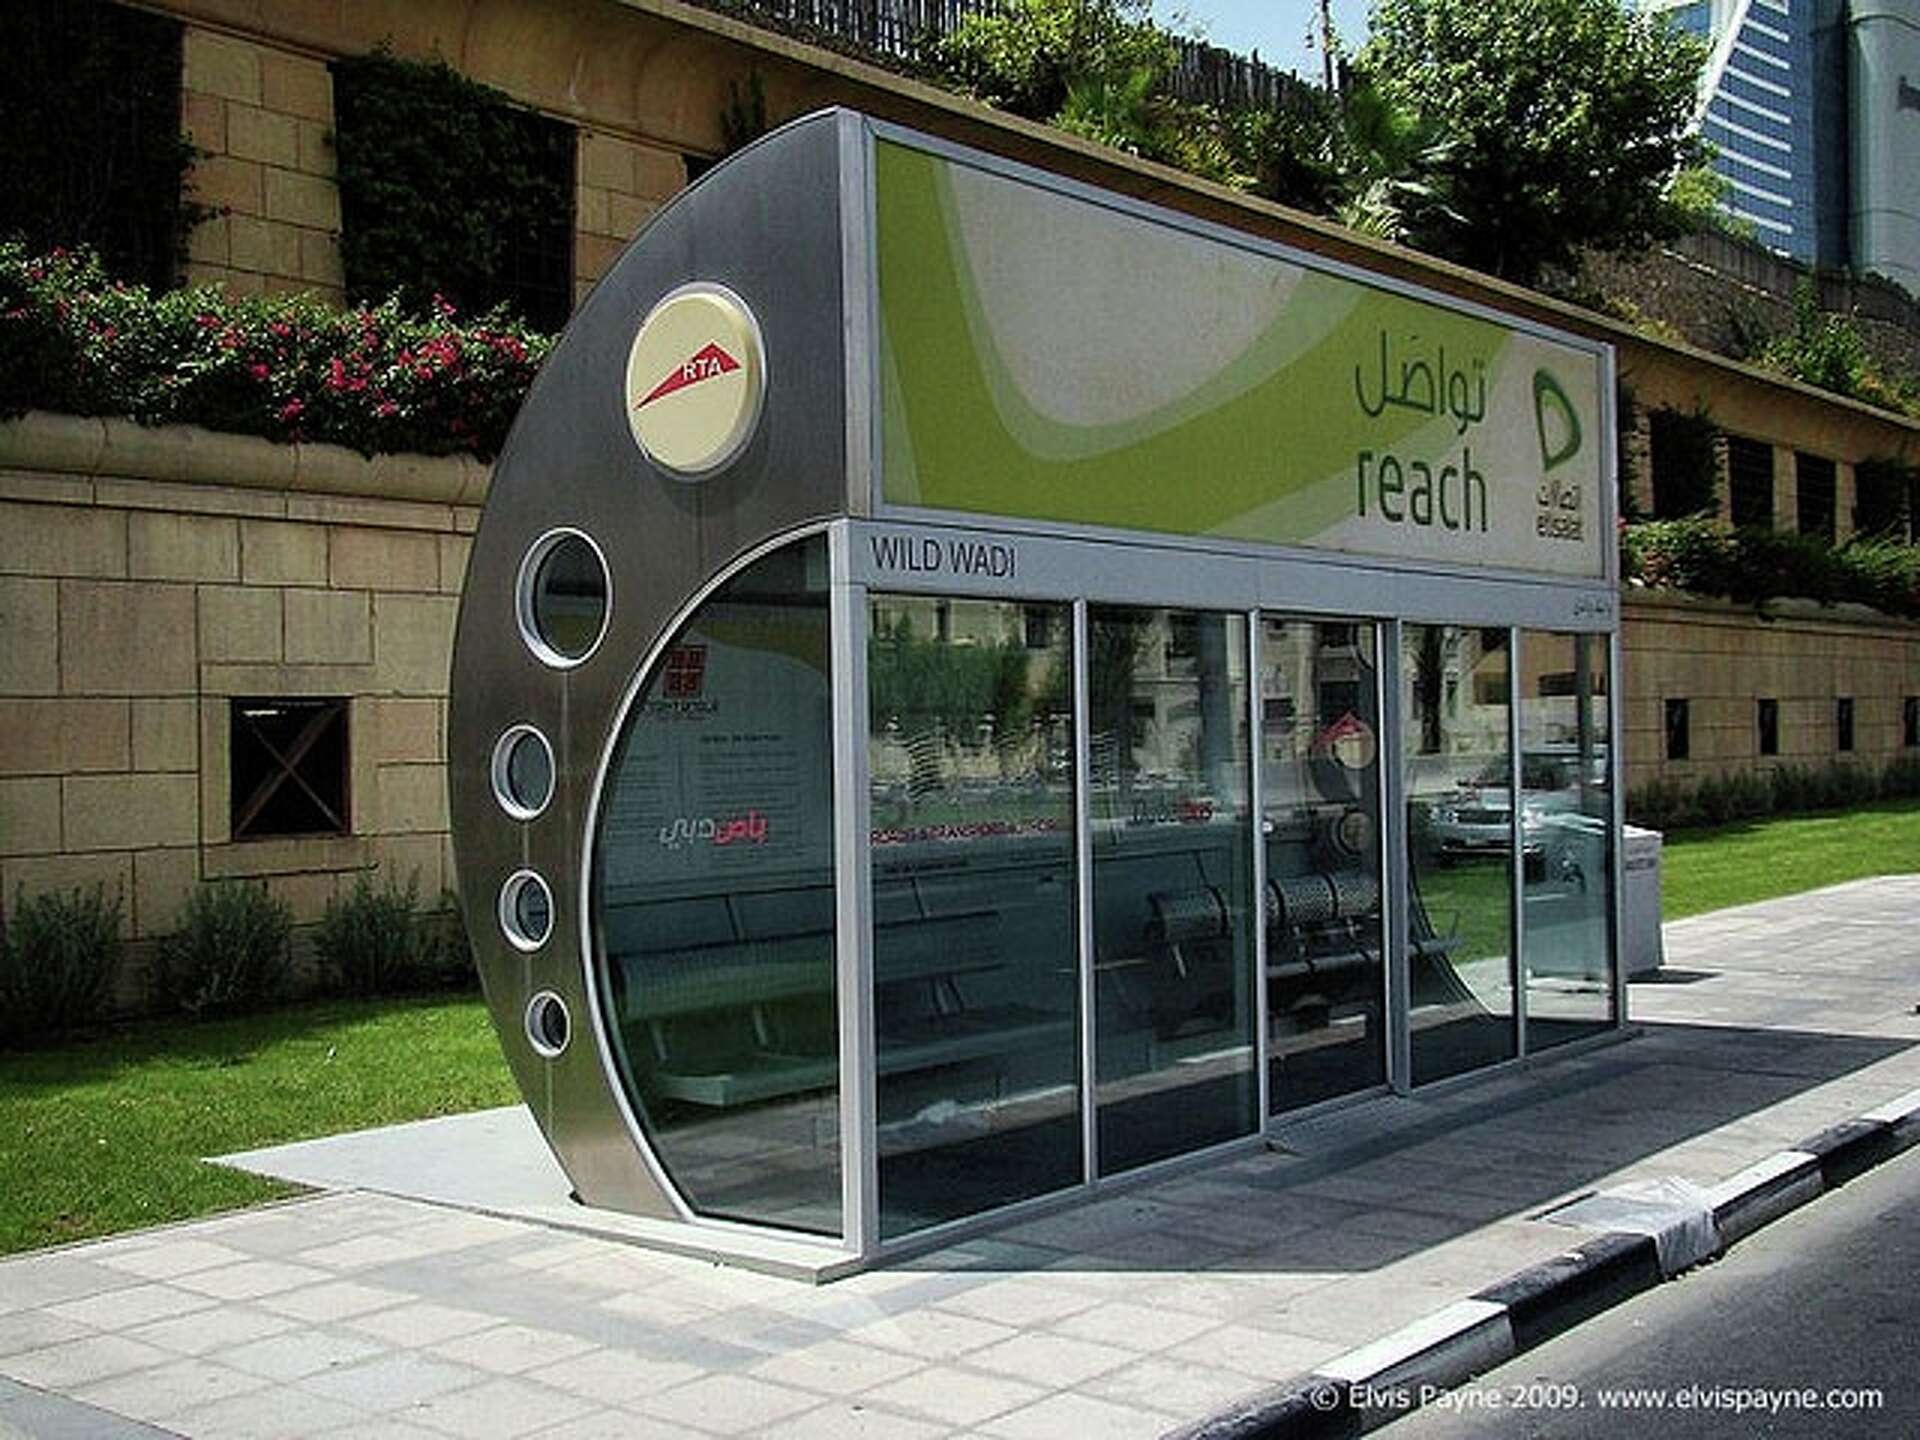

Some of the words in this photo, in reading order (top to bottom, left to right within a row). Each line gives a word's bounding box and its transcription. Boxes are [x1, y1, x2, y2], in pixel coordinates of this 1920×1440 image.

[682, 357, 723, 381] RTA
[1357, 446, 1487, 533] reach
[871, 536, 942, 572] WILD
[949, 541, 1016, 578] WADI
